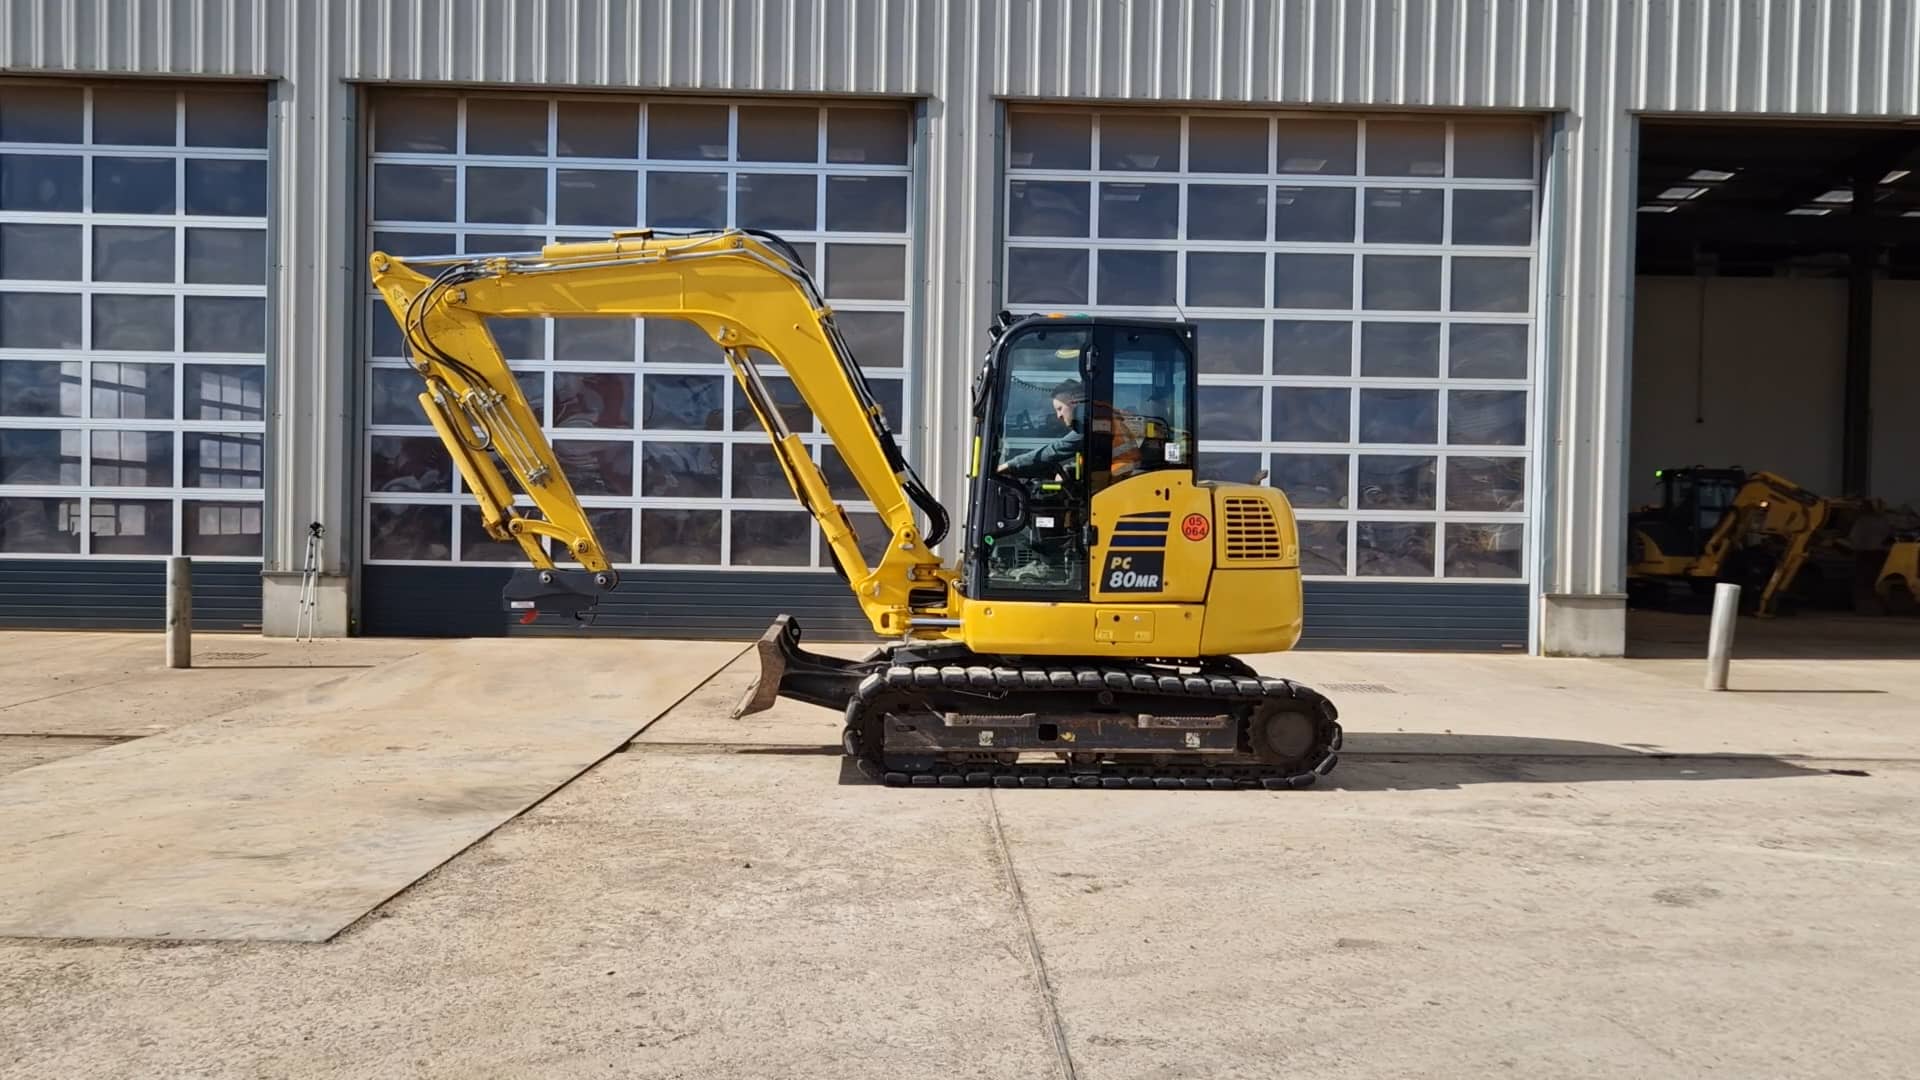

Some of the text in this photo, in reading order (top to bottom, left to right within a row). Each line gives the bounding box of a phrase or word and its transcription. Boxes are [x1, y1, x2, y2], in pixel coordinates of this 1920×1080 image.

[1188, 517, 1202, 526] 05
[1185, 527, 1205, 536] 064
[1110, 556, 1132, 570] PC
[1109, 571, 1158, 588] 80MR
